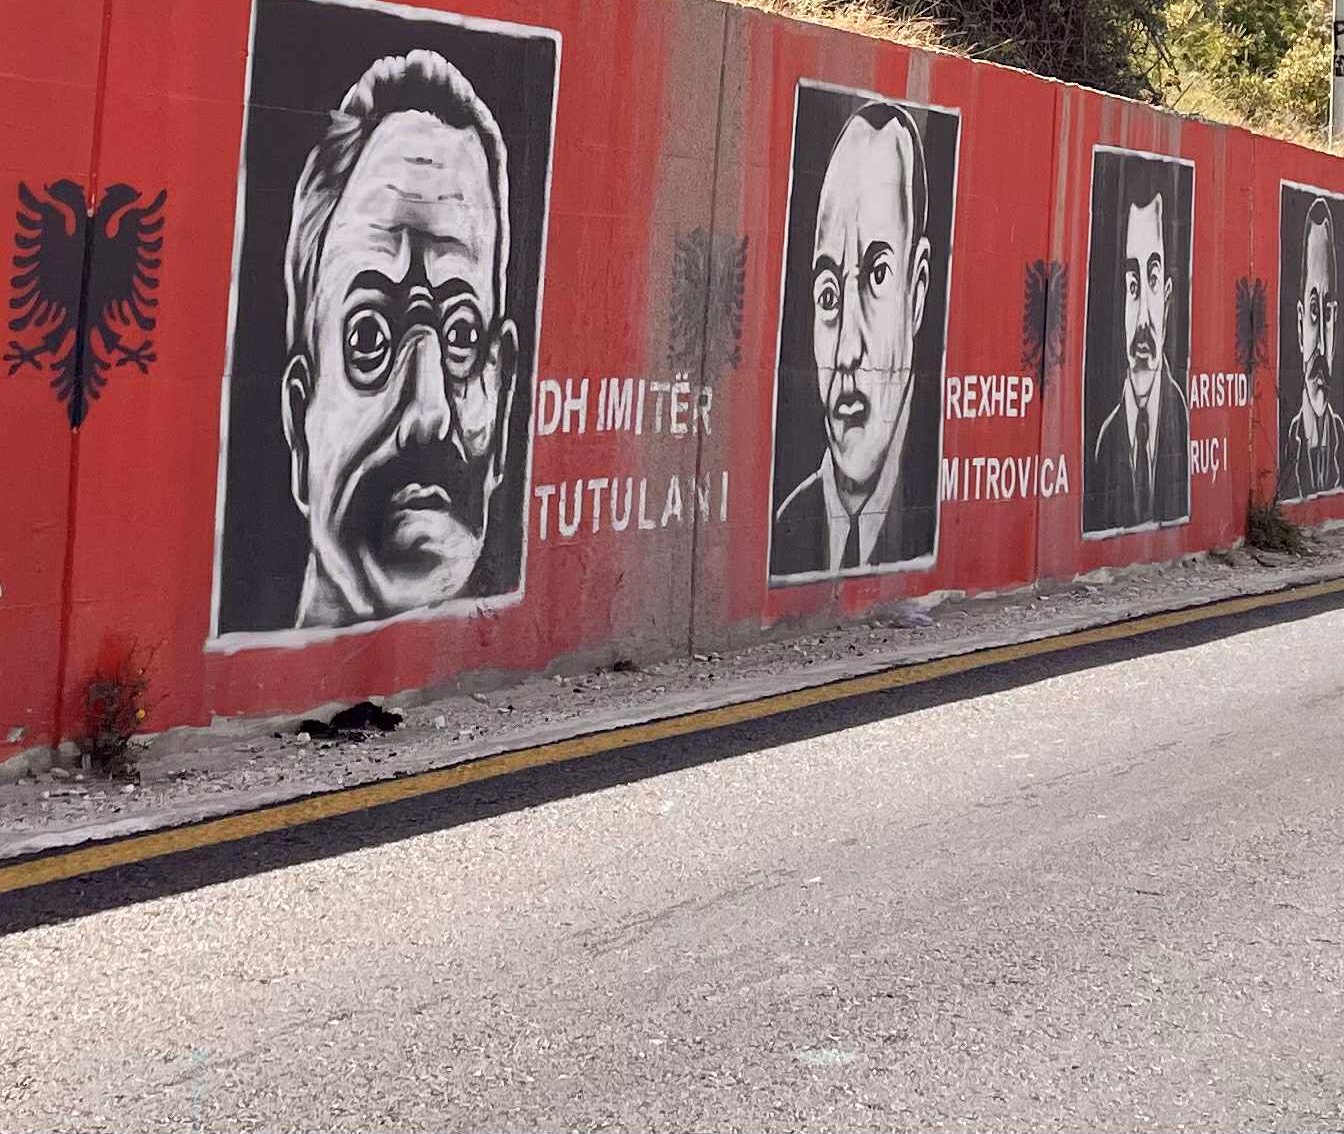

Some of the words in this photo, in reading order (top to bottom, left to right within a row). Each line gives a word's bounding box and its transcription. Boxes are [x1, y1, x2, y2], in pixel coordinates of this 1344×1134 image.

[946, 374, 1034, 420] REXHEP
[941, 454, 1069, 501] MITROVICA
[1190, 437, 1228, 483] RUÇI
[535, 471, 729, 541] TUTULANI
